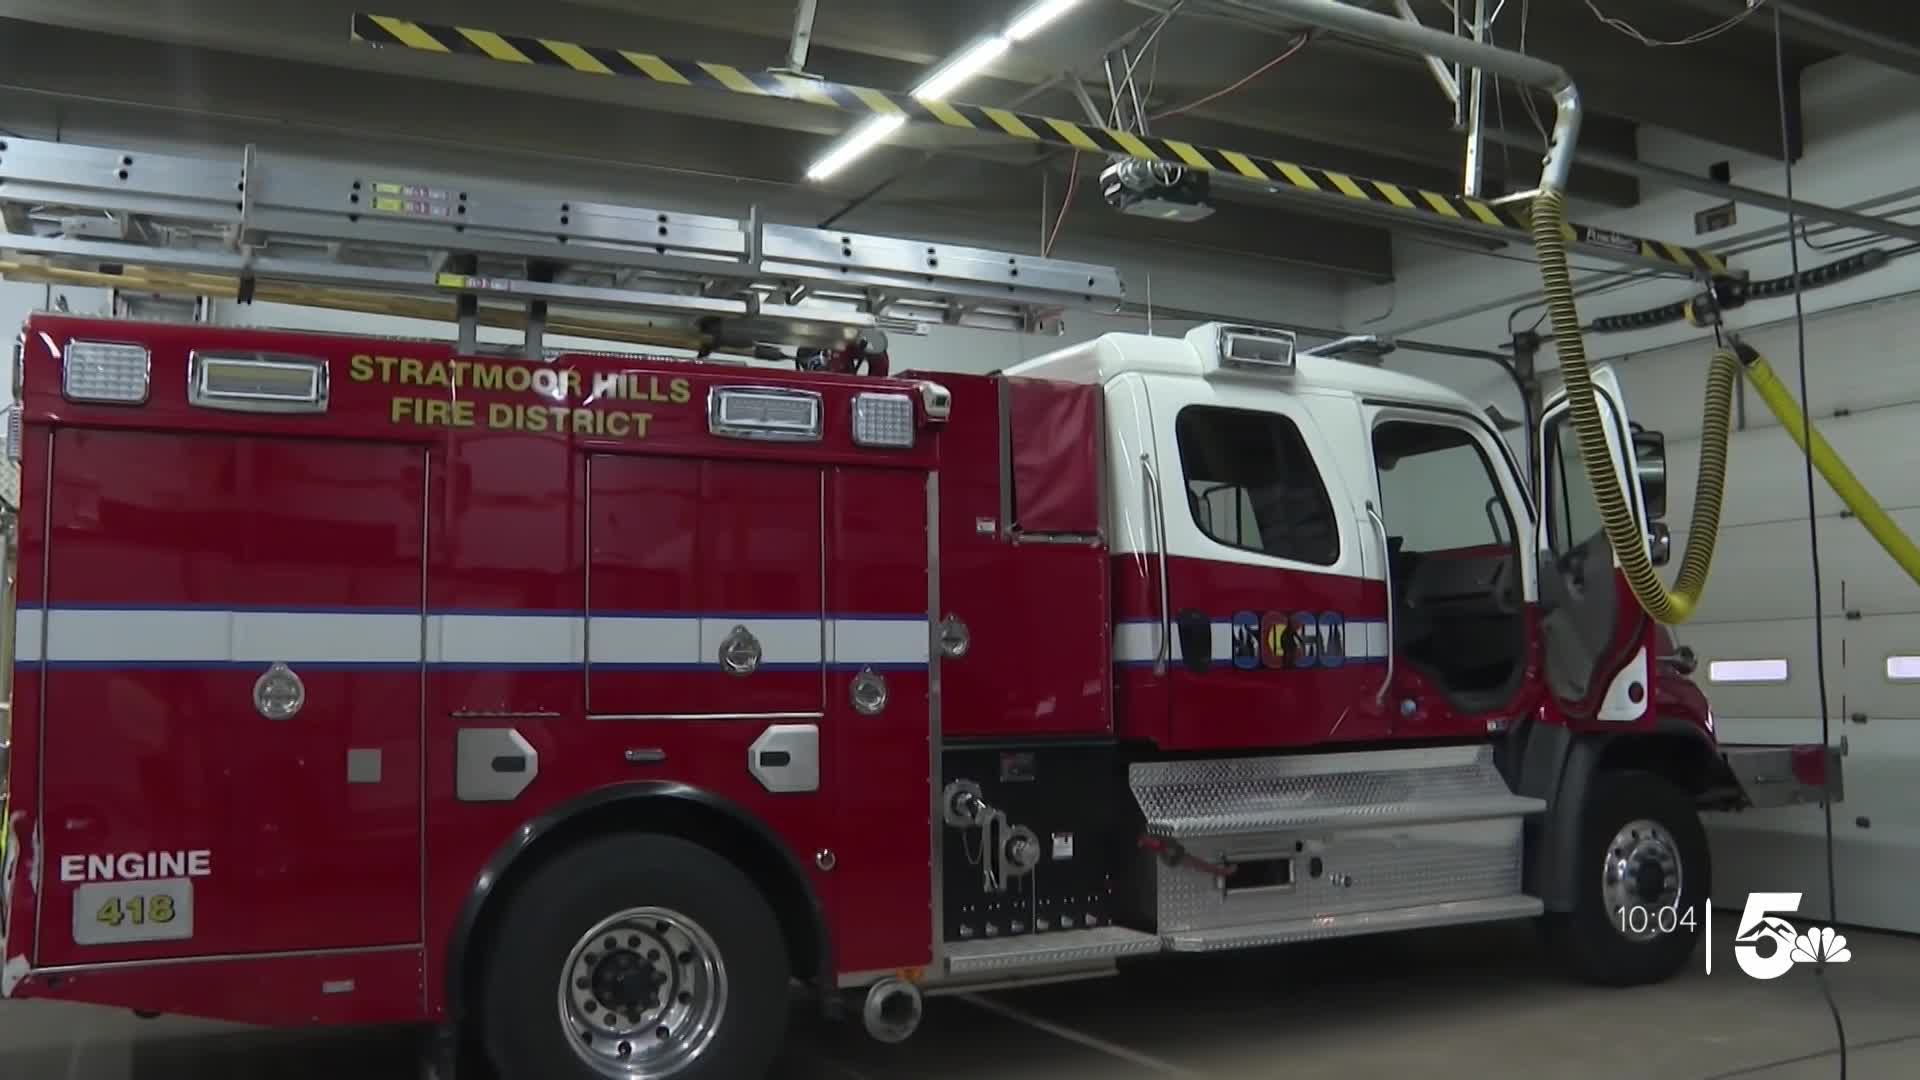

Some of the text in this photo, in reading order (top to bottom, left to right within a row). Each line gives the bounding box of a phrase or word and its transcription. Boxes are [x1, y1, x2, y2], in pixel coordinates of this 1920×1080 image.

[350, 355, 691, 403] STRATMOOR HILLS
[391, 397, 653, 438] FIRE DISTRICT
[60, 850, 211, 881] ENGINE
[96, 895, 175, 926] 418
